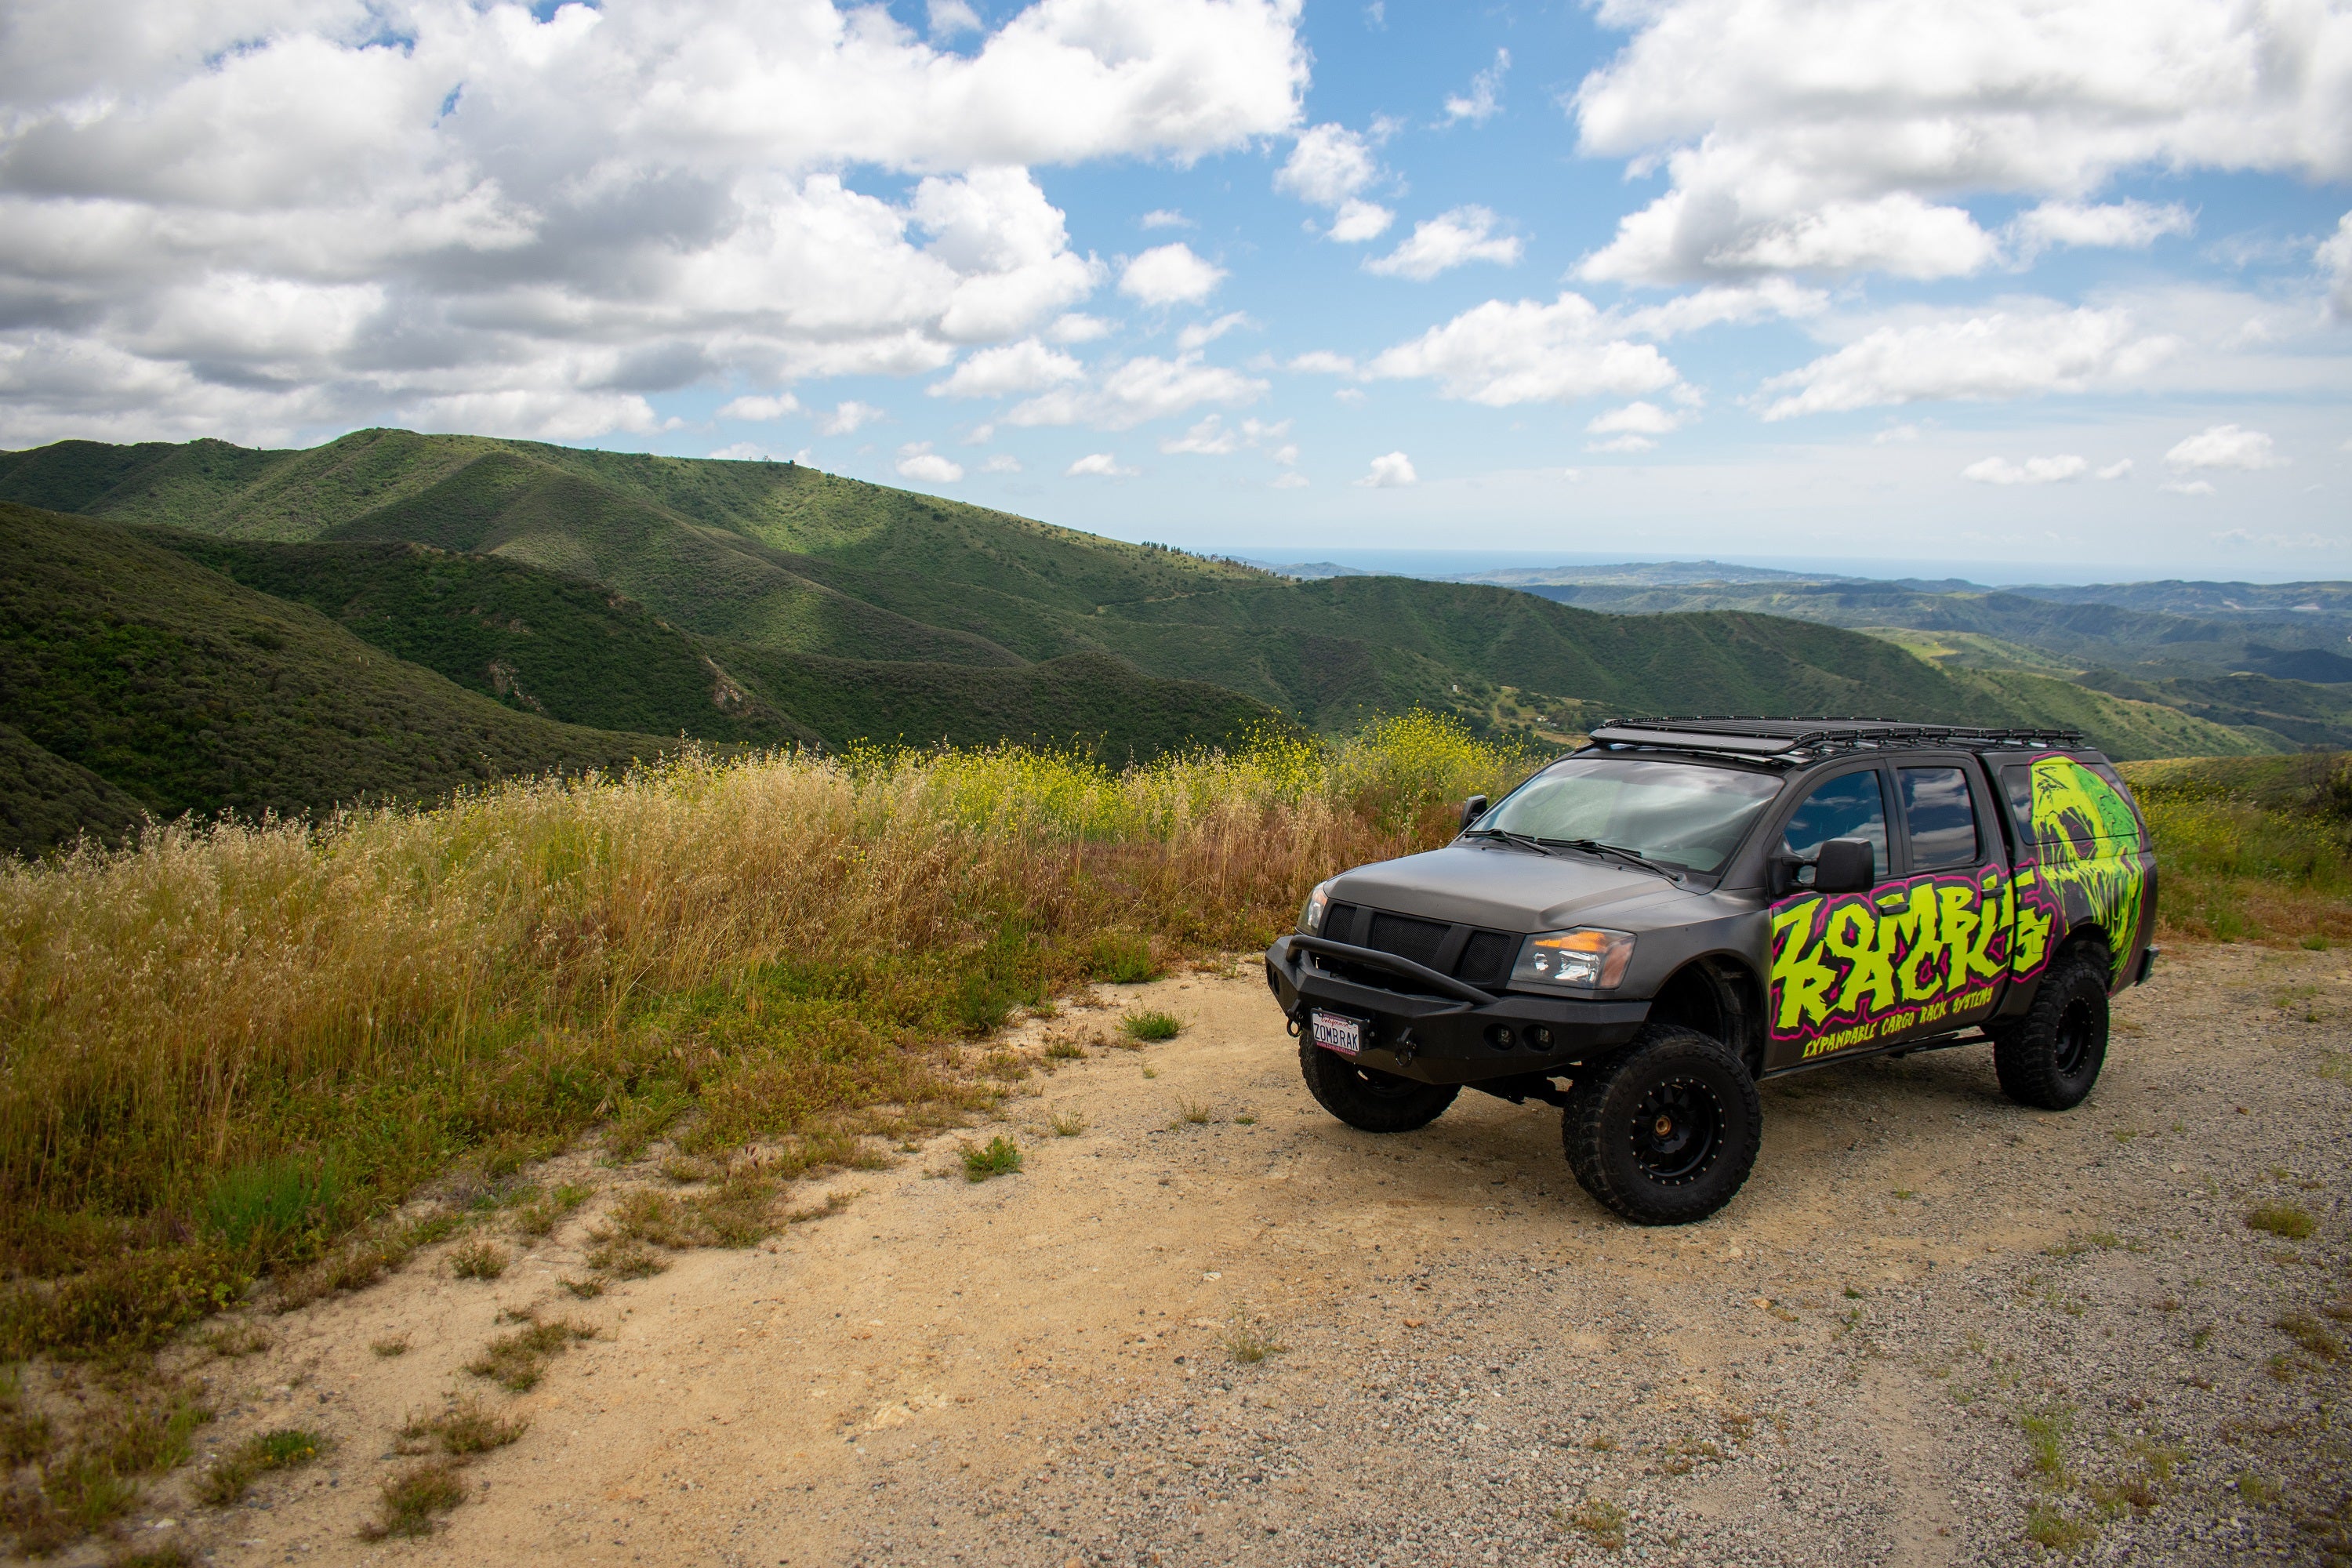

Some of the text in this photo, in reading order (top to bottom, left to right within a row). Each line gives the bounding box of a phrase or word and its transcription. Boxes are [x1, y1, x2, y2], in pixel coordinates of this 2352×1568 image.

[1776, 909, 2053, 1029] RACKS
[1314, 1023, 1359, 1051] ZOMBRAK
[1321, 1016, 1352, 1029] California
[1802, 986, 1994, 1058] EXPANDABLE CARGO RACK SYSTEMS
